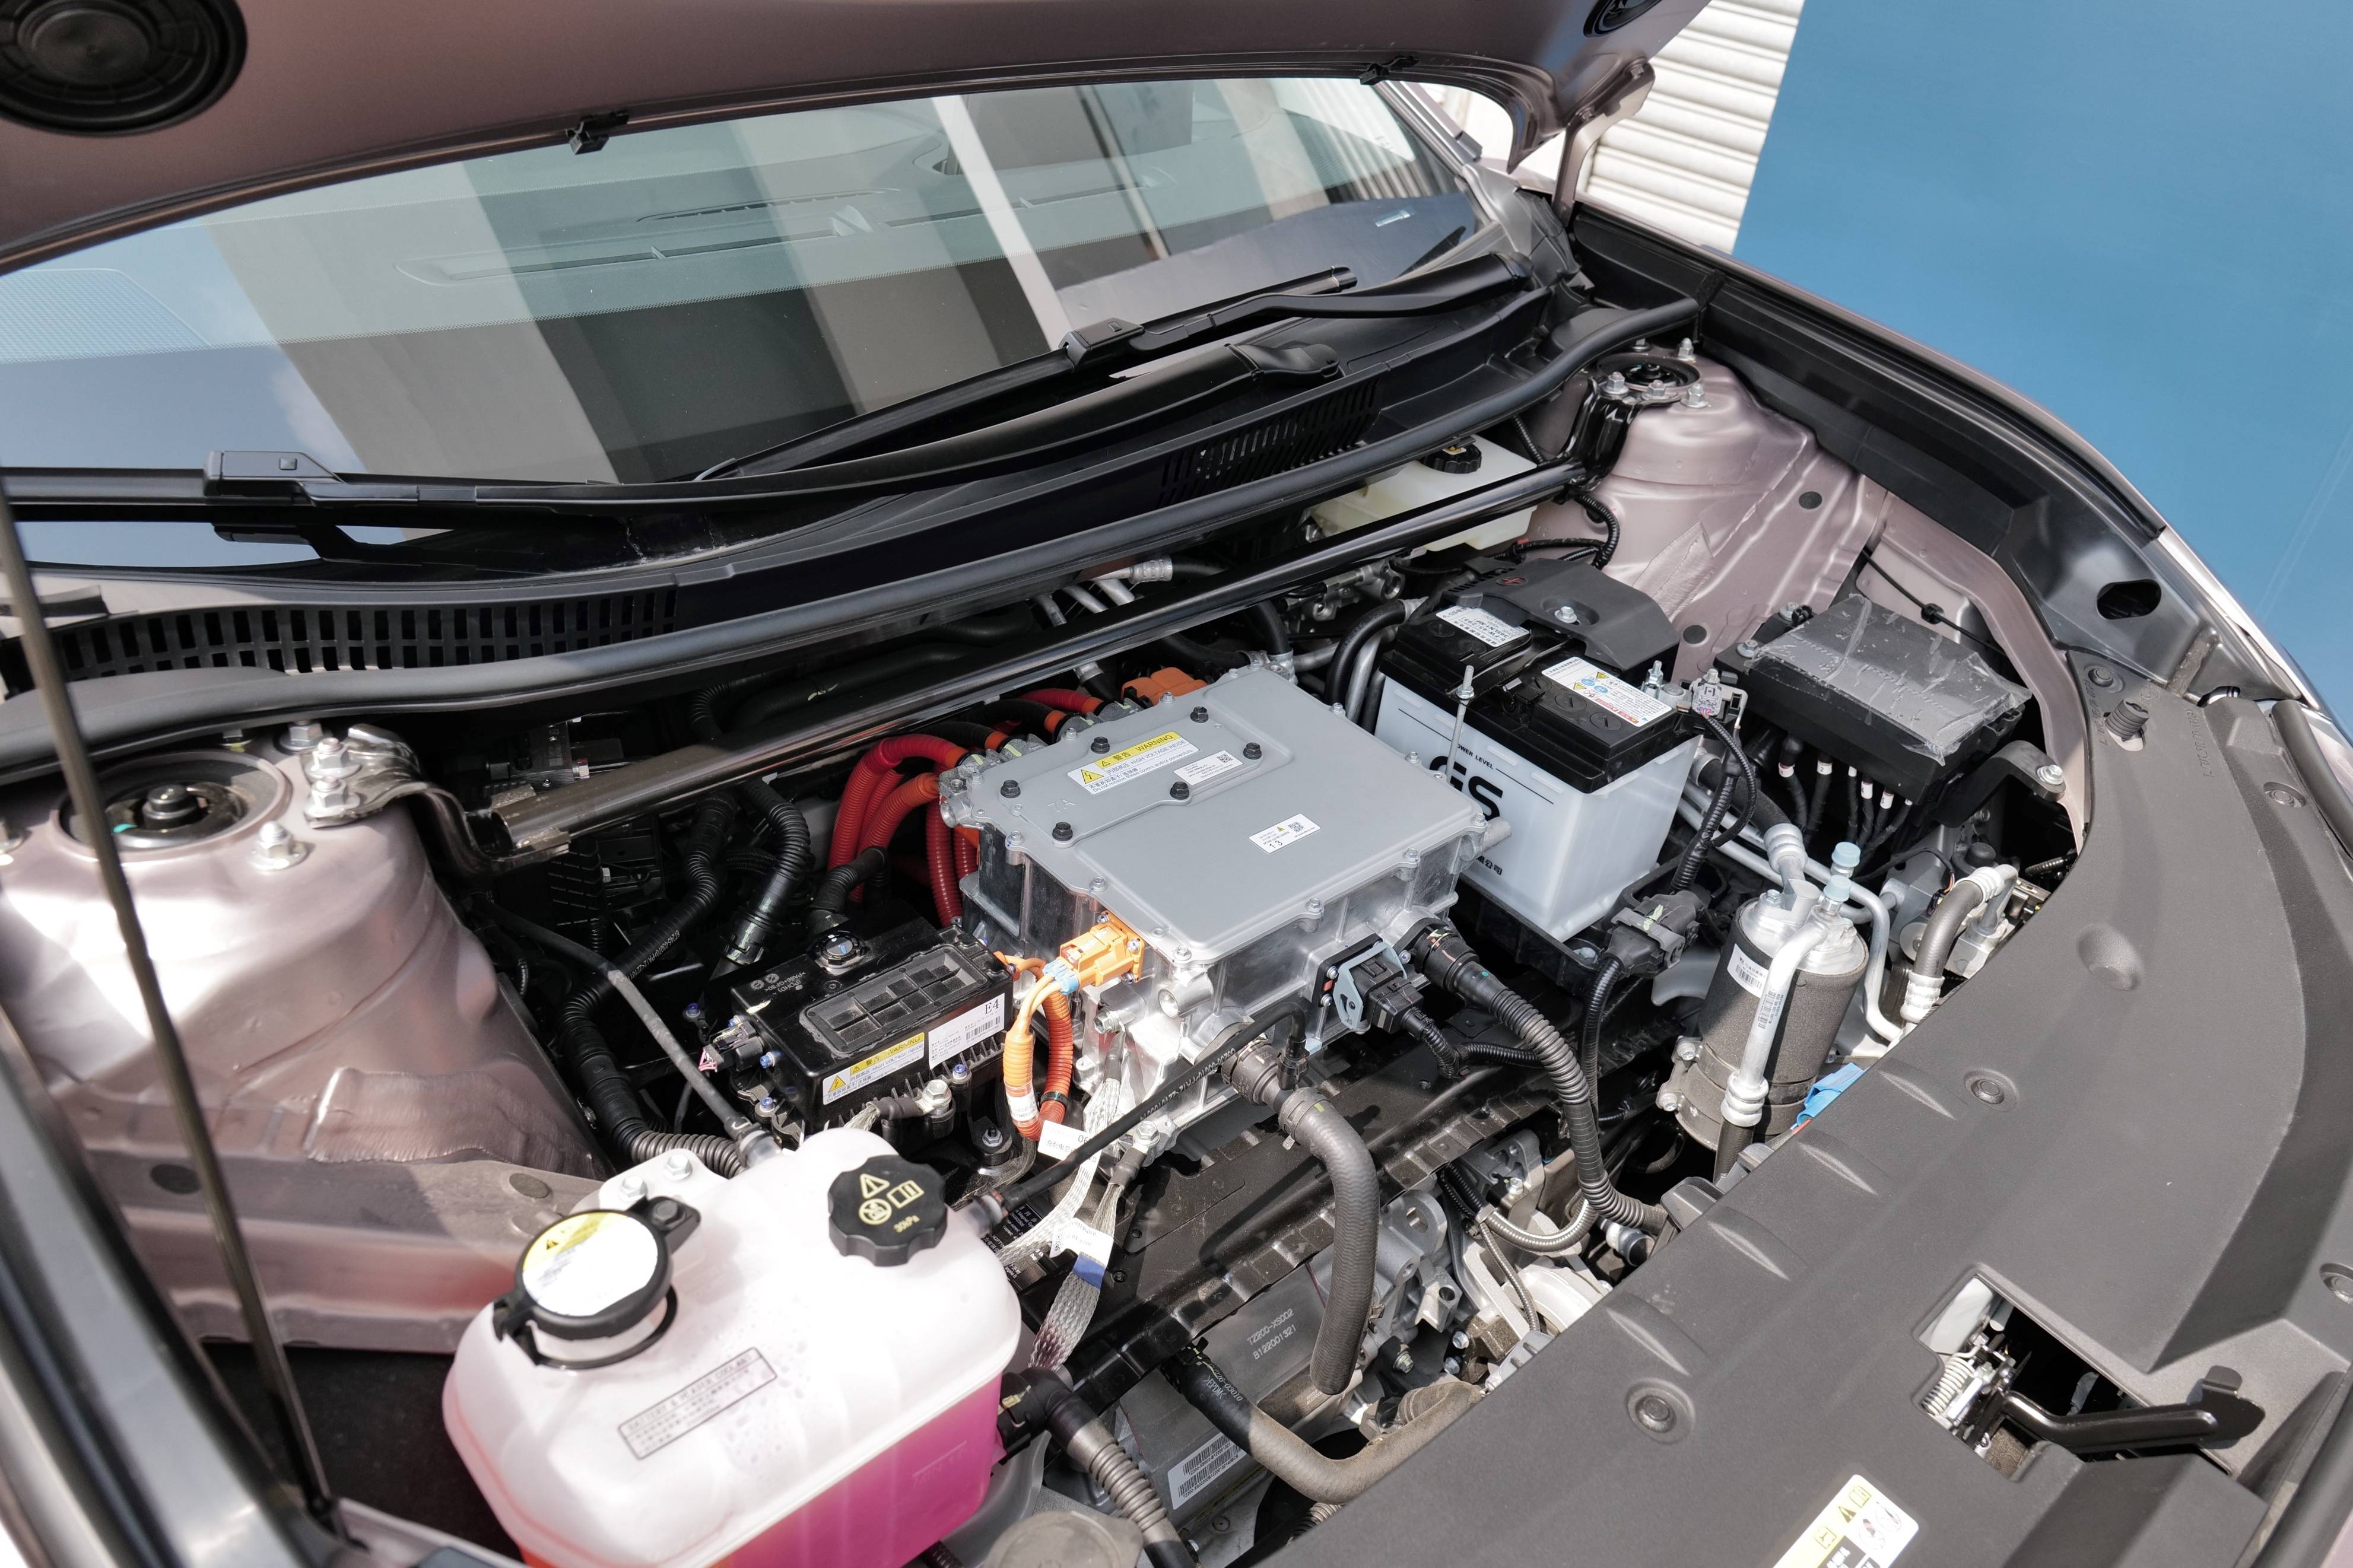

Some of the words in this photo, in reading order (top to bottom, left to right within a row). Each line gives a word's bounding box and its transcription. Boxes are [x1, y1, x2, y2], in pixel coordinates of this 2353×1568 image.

[1107, 762, 1130, 774] 内部高压
[1131, 756, 1145, 765] HIGH
[1144, 746, 1168, 759] VOLTAGE
[1168, 740, 1186, 749] INSIDE
[1113, 750, 1131, 762] 警告
[1135, 733, 1173, 752] WARNING
[1475, 754, 1494, 769] LEVEL
[1109, 777, 1126, 785] remove
[1125, 771, 1140, 779] these
[983, 998, 1000, 1014] E4
[887, 1036, 920, 1055] WARNING
[850, 1069, 870, 1082] 内部高压
[872, 1062, 884, 1070] HIGH
[885, 1051, 906, 1065] VOLTAGE
[907, 1044, 923, 1054] INSIDE
[842, 1086, 858, 1095] remove
[857, 1079, 869, 1088] these
[869, 1073, 884, 1082] covers
[1246, 1307, 1295, 1346] TZ200-XS002
[1251, 1323, 1297, 1360] B122001321
